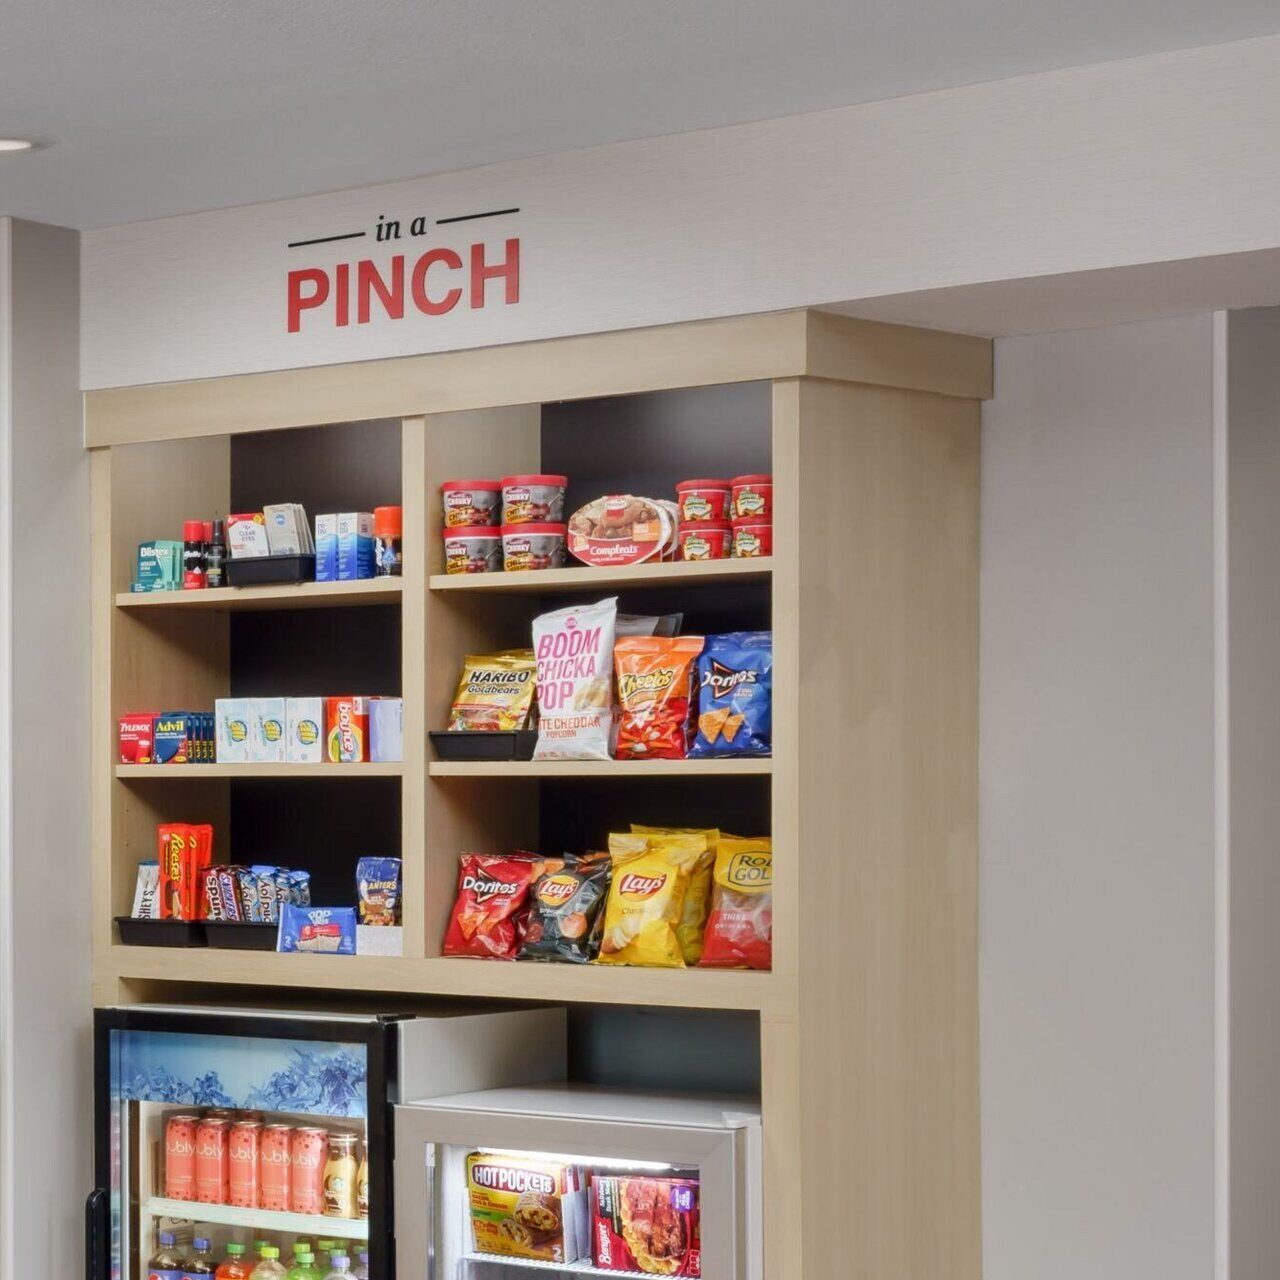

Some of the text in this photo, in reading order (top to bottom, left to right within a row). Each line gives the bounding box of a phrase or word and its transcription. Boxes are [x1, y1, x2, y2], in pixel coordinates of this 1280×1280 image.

[375, 215, 427, 241] in a
[287, 238, 521, 334] PINCH
[590, 544, 639, 557] Compleats
[537, 626, 602, 660] BOOM
[469, 671, 530, 684] HARIBO
[537, 656, 595, 682] CHICKA
[467, 684, 520, 695] Goldbears
[619, 667, 674, 698] Cheetos
[120, 723, 150, 732] TYLENOL
[156, 720, 184, 732] Advil
[338, 702, 354, 753] bounce
[554, 713, 601, 730] CHEDDAR
[171, 833, 185, 884] Reese's
[739, 855, 773, 867] ROL
[734, 868, 773, 881] GOL
[368, 881, 397, 890] ANTERS
[462, 875, 518, 894] Doritos
[207, 875, 223, 921] ounds
[167, 1140, 196, 1157] ubly
[197, 1143, 224, 1158] ubly
[229, 1146, 258, 1162] ubly
[262, 1150, 291, 1167] ubly
[474, 1166, 553, 1193] HOT POCKETS
[598, 1221, 612, 1265] Banquet
